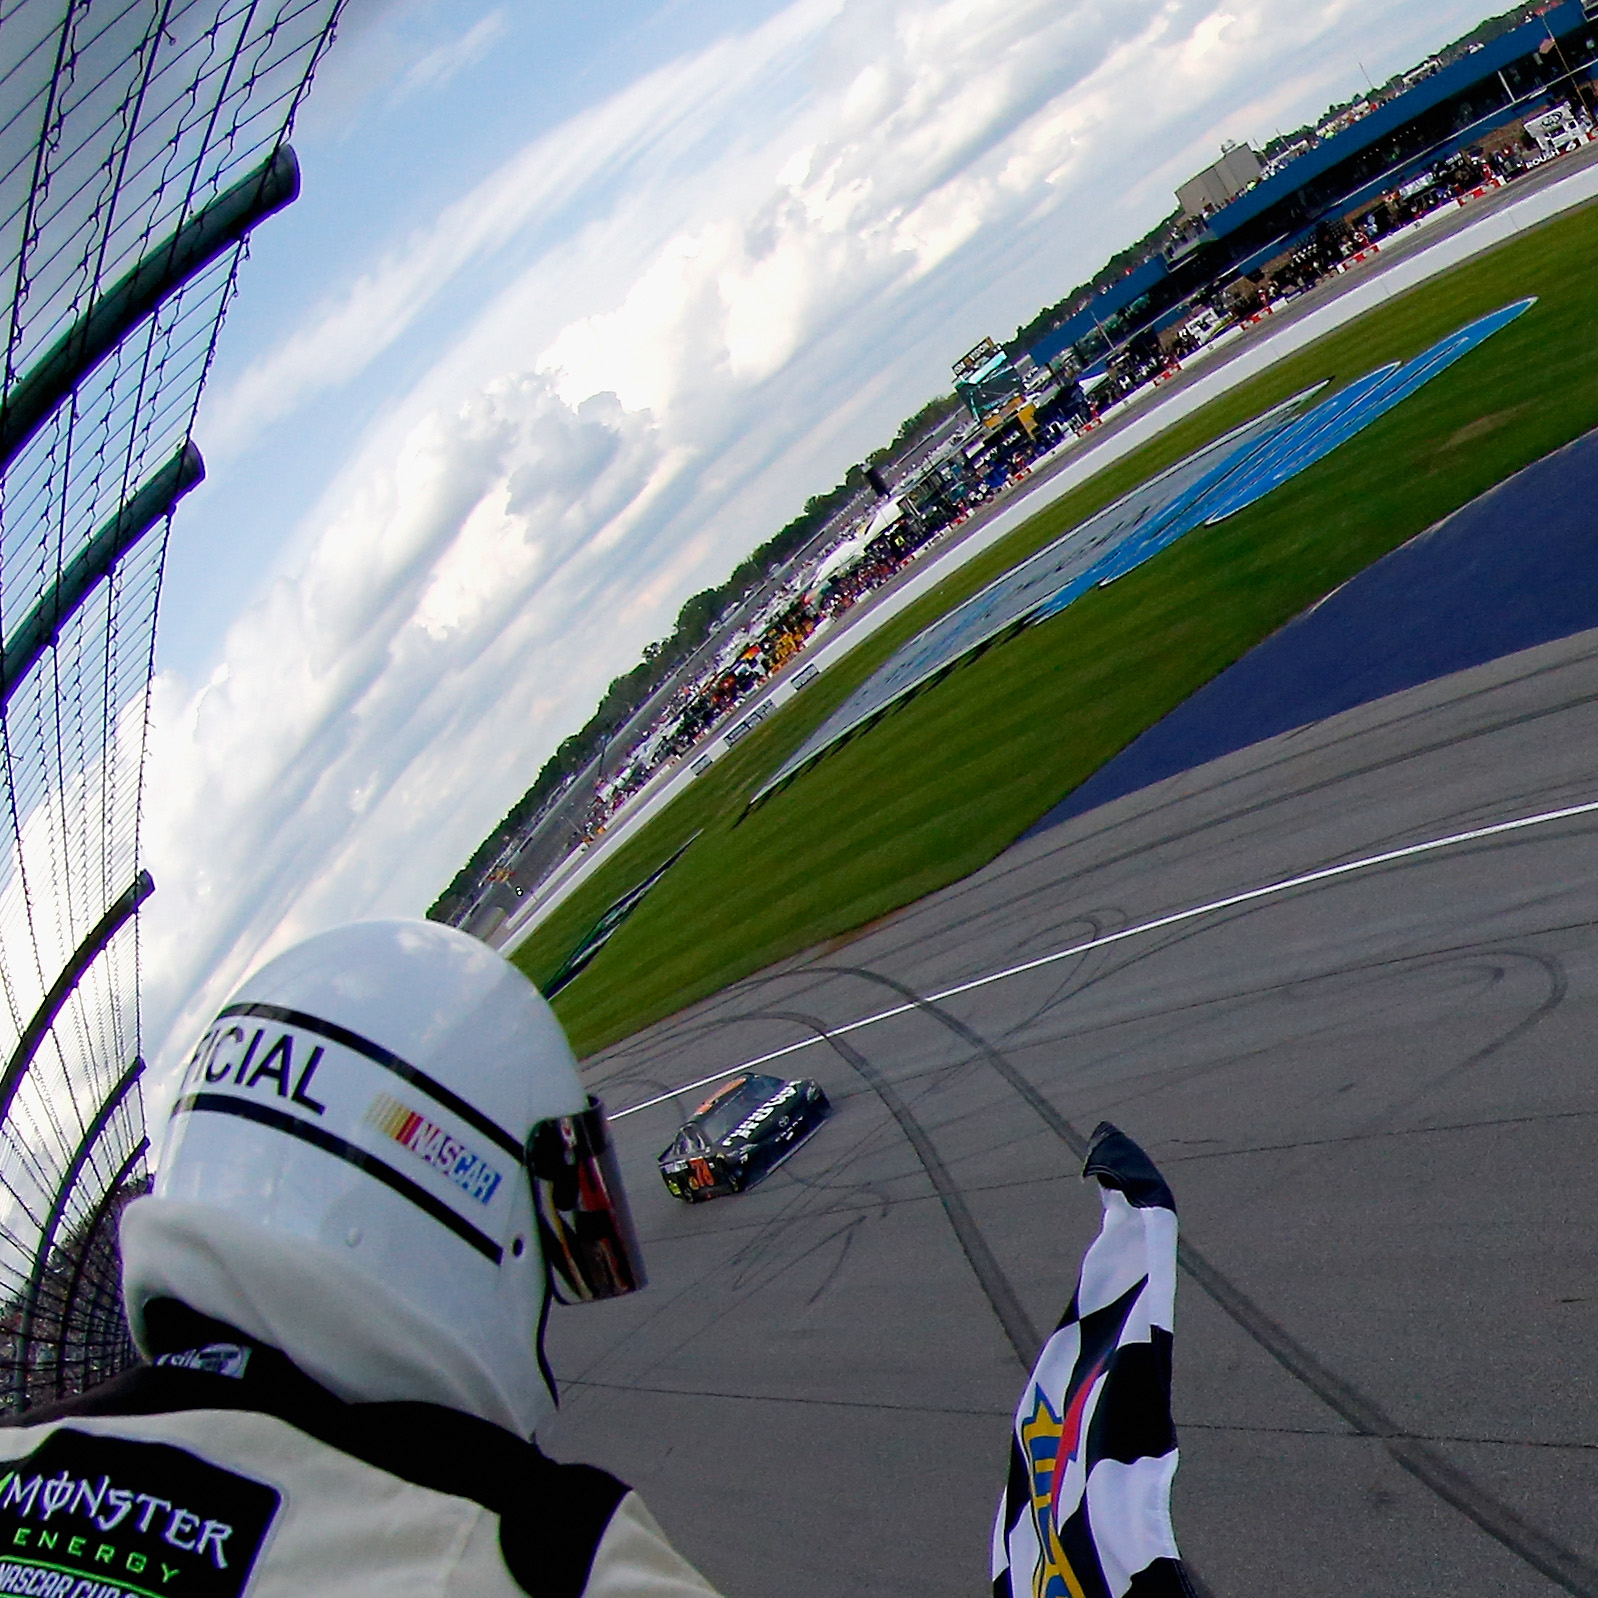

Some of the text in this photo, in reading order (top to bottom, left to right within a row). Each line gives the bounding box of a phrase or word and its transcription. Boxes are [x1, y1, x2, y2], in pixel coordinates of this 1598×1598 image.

[408, 1116, 502, 1204] NASCAR
[3, 1470, 233, 1570] MONSTER
[13, 1527, 181, 1583] ENERGY
